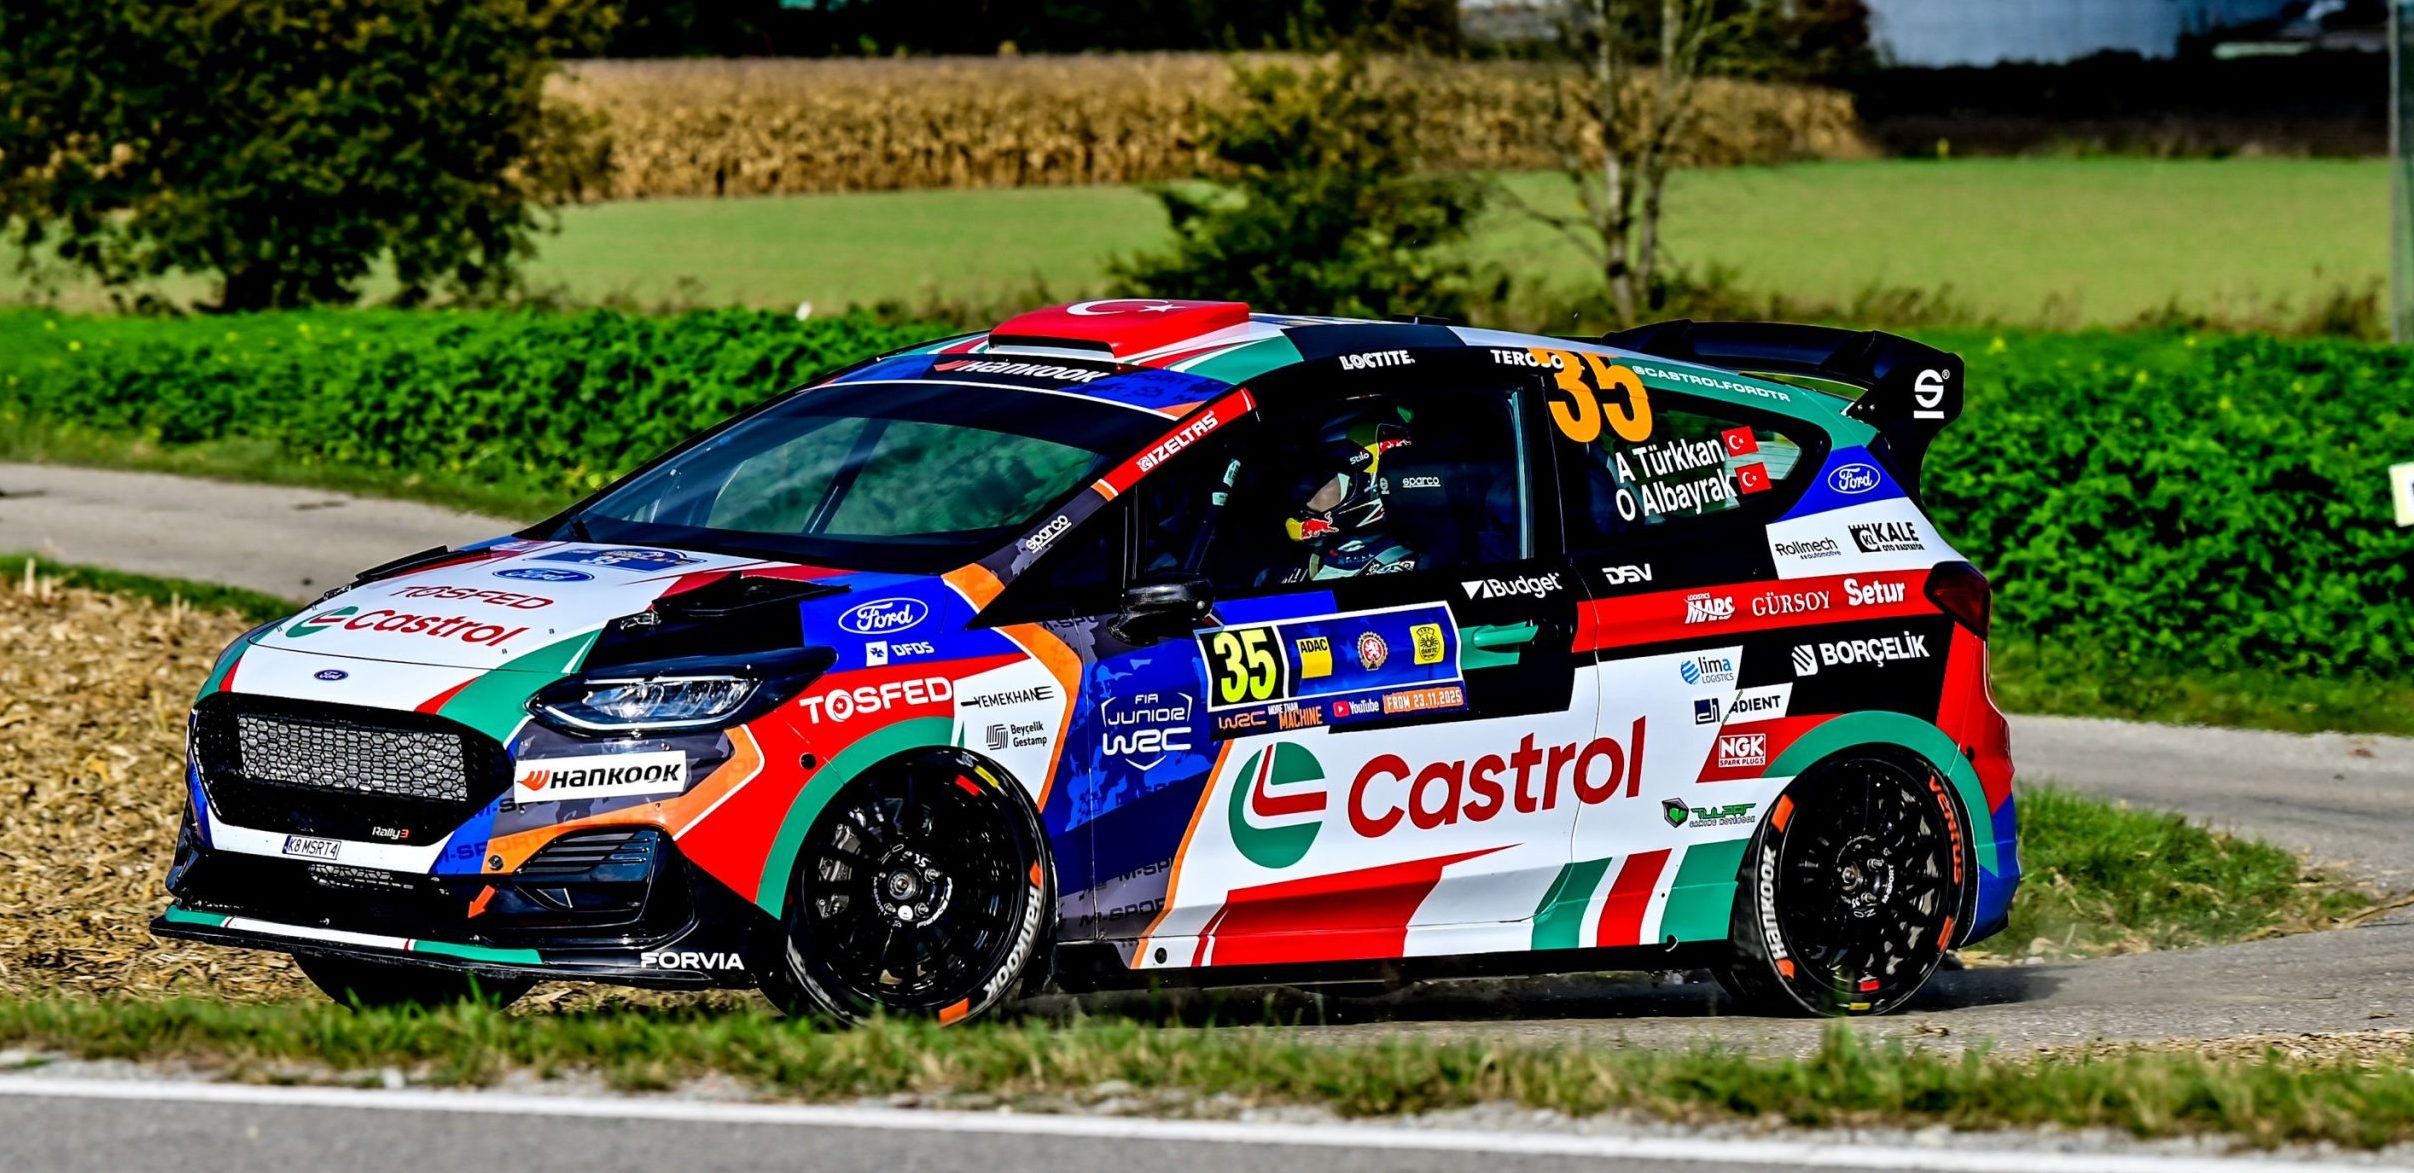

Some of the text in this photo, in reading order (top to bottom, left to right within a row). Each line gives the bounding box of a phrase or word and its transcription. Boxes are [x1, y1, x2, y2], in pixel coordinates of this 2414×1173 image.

[1632, 365, 1791, 402] @CASTROLFORDTR
[1527, 347, 1653, 443] 35
[1615, 434, 1726, 484] A Türkkan
[1402, 476, 1441, 489] sparco
[1838, 467, 1873, 491] Ford
[1615, 468, 1738, 522] O Albayrak
[1025, 514, 1073, 554] sparco
[1871, 521, 1920, 543] KALE
[1775, 536, 1839, 557] Rollmech
[1487, 572, 1563, 598] Budget
[1602, 563, 1653, 585] DSV
[389, 586, 555, 610] TOSFED
[1843, 578, 1906, 606] Setur
[1684, 596, 1736, 624] MARS
[1752, 590, 1830, 617] GÜRSOY
[856, 602, 914, 631] Ford
[344, 609, 530, 647] Castrol
[891, 641, 935, 657] DFDS
[1300, 637, 1328, 653] ADAC
[1819, 630, 1931, 667] BORÇELİK
[1213, 628, 1277, 703] 35
[1698, 656, 1733, 674] lima
[1701, 672, 1734, 684] LOGISTICS
[799, 676, 953, 725] TOSFED
[970, 685, 1055, 709] YEMEKHANE
[1135, 693, 1159, 704] FIA
[1349, 700, 1380, 715] YouTube
[1386, 689, 1463, 709] FROM 23.11.2025
[1728, 694, 1782, 714] ADIENT
[1107, 707, 1186, 726] JUNIOR
[1267, 702, 1299, 715] MORE THAN
[1278, 705, 1323, 730] MACHINE
[1010, 721, 1044, 737] Beyçelik
[1218, 710, 1267, 730] WRC
[1013, 735, 1048, 748] Gestamp
[1102, 727, 1192, 756] WRC
[1720, 735, 1765, 758] NGK
[1719, 757, 1764, 767] SPARK PLUGS
[1347, 715, 1646, 839] Castrol
[287, 836, 302, 852] K8
[372, 826, 410, 840] Rally3
[640, 951, 745, 970] FORVIA
